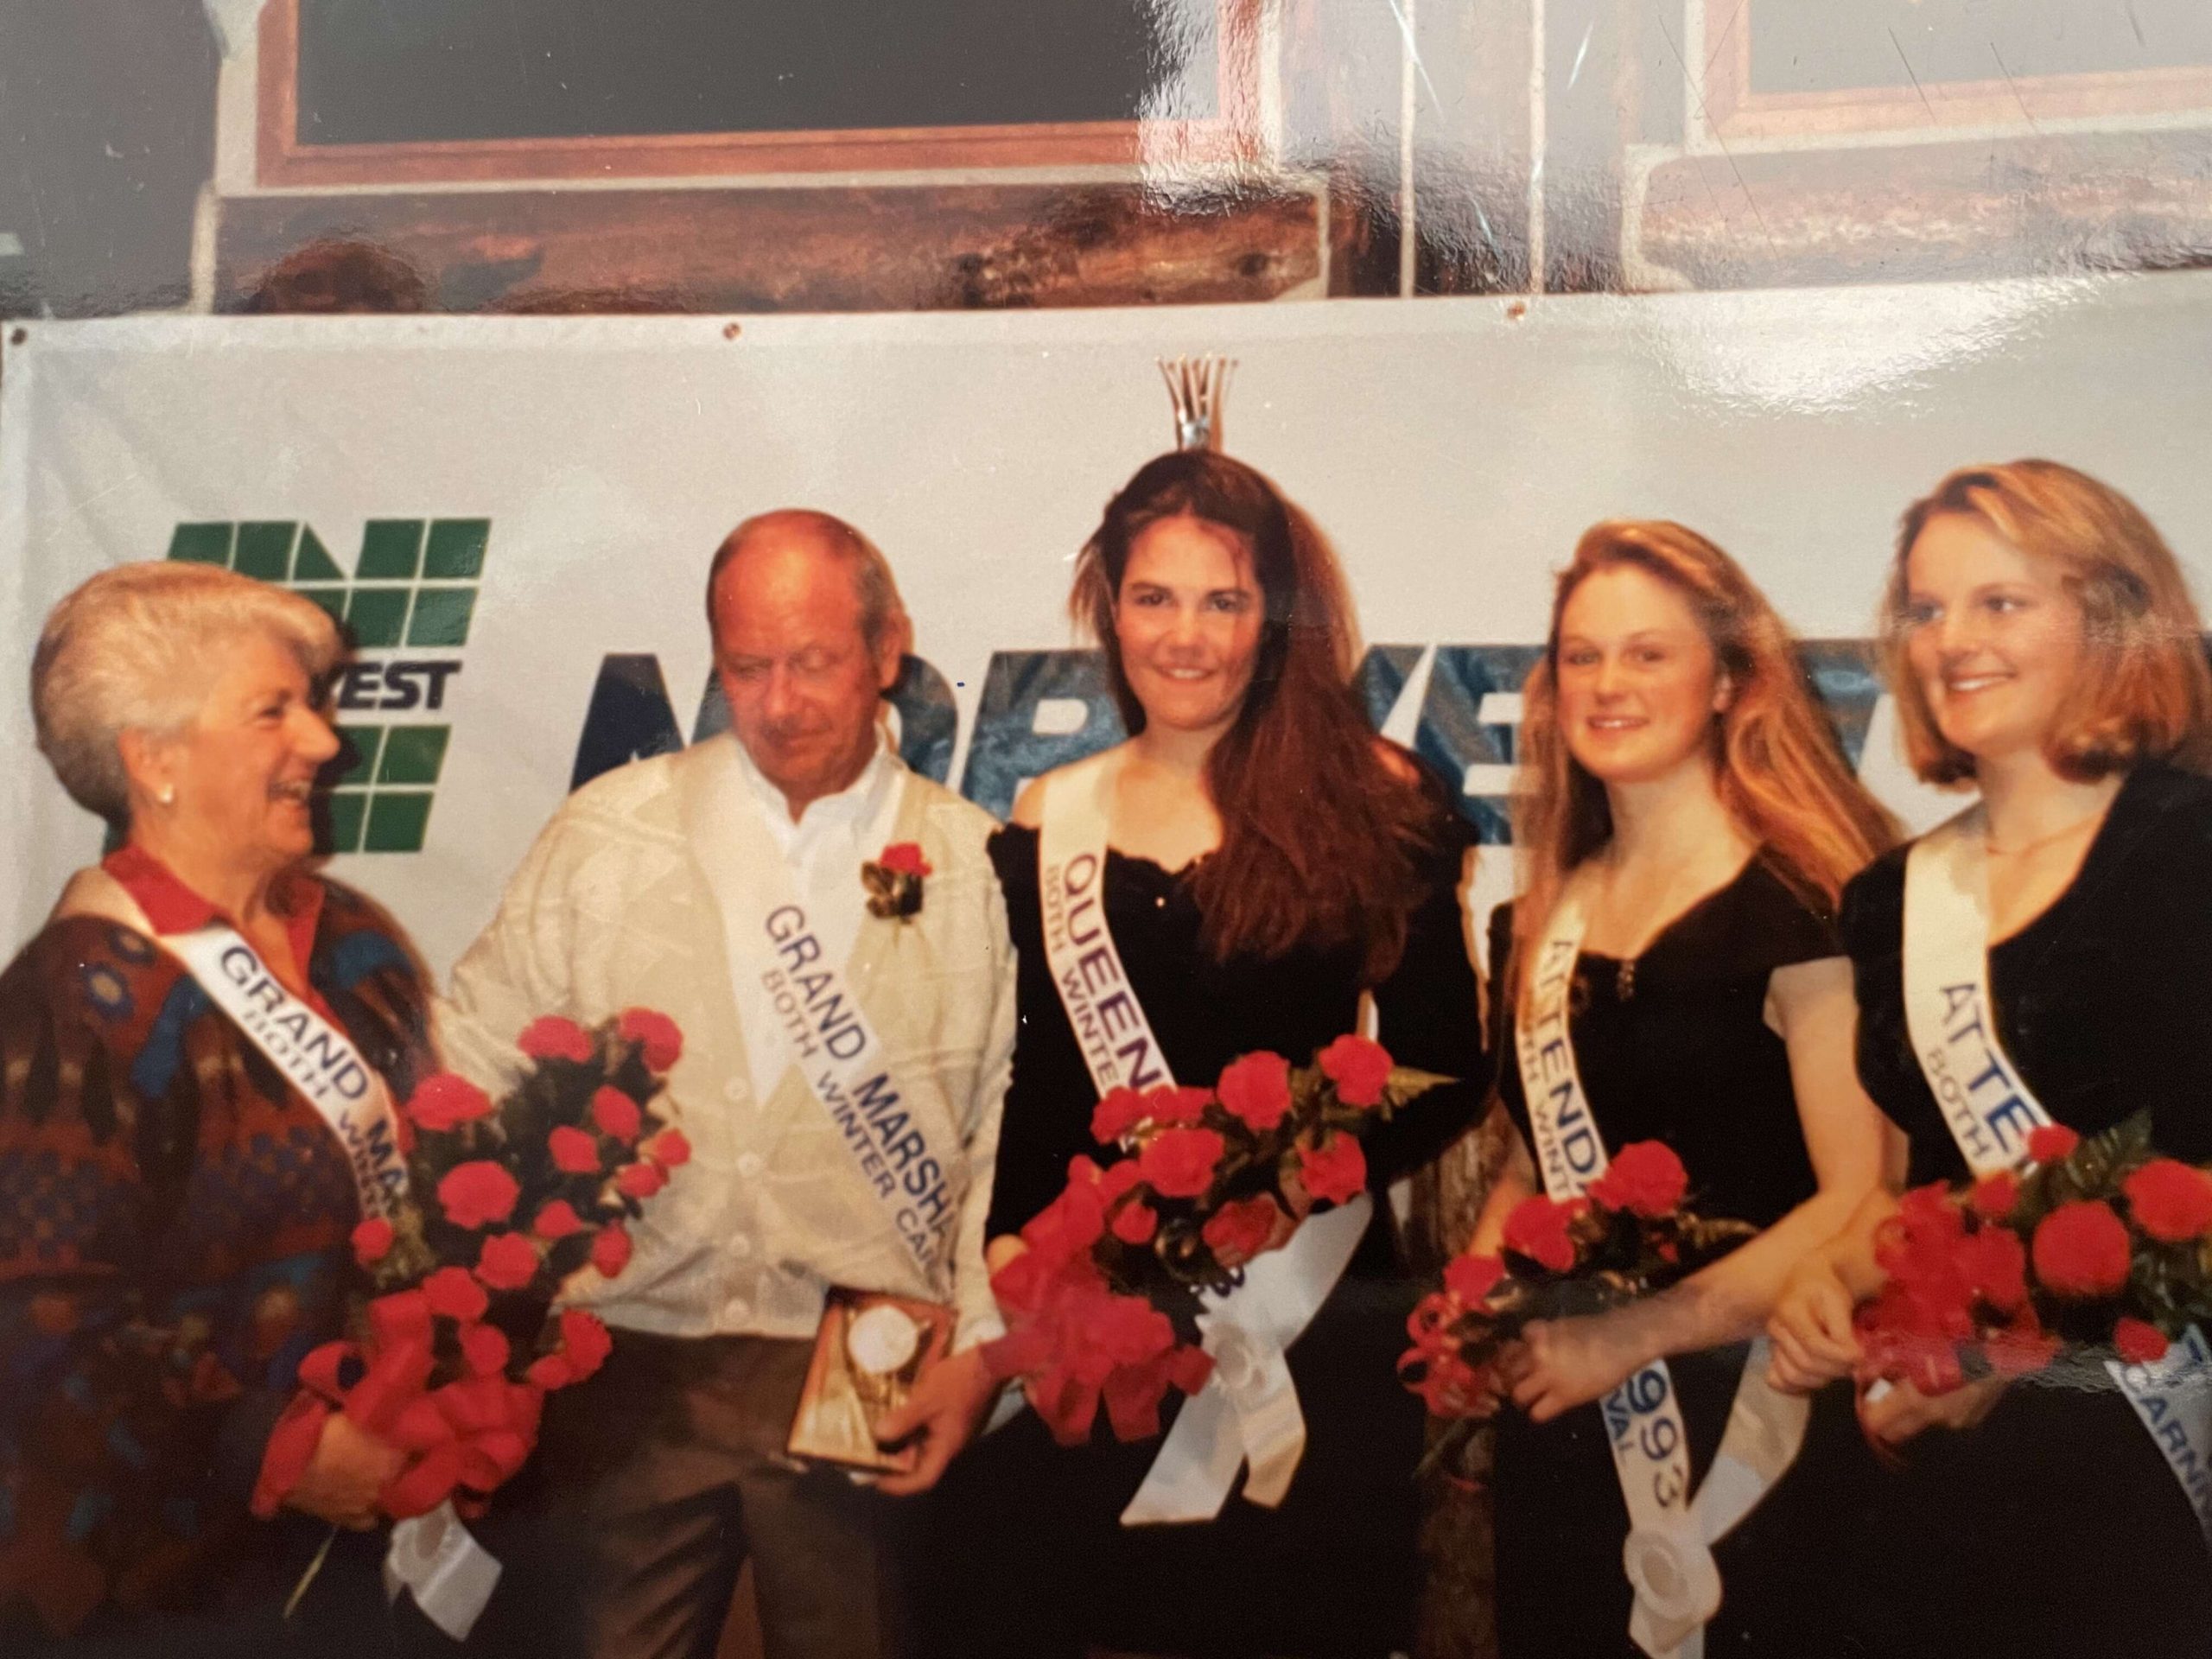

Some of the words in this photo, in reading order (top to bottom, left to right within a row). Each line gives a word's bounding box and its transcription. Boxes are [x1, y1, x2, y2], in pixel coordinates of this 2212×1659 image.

[220, 945, 369, 1100] GRAND
[765, 904, 868, 1061] GRAND
[1064, 854, 1162, 1089] QUEEN
[242, 1007, 331, 1099] BOTH
[760, 968, 819, 1058] BOTH
[816, 1069, 897, 1198] WINTER
[1927, 1047, 1991, 1158] BOTH
